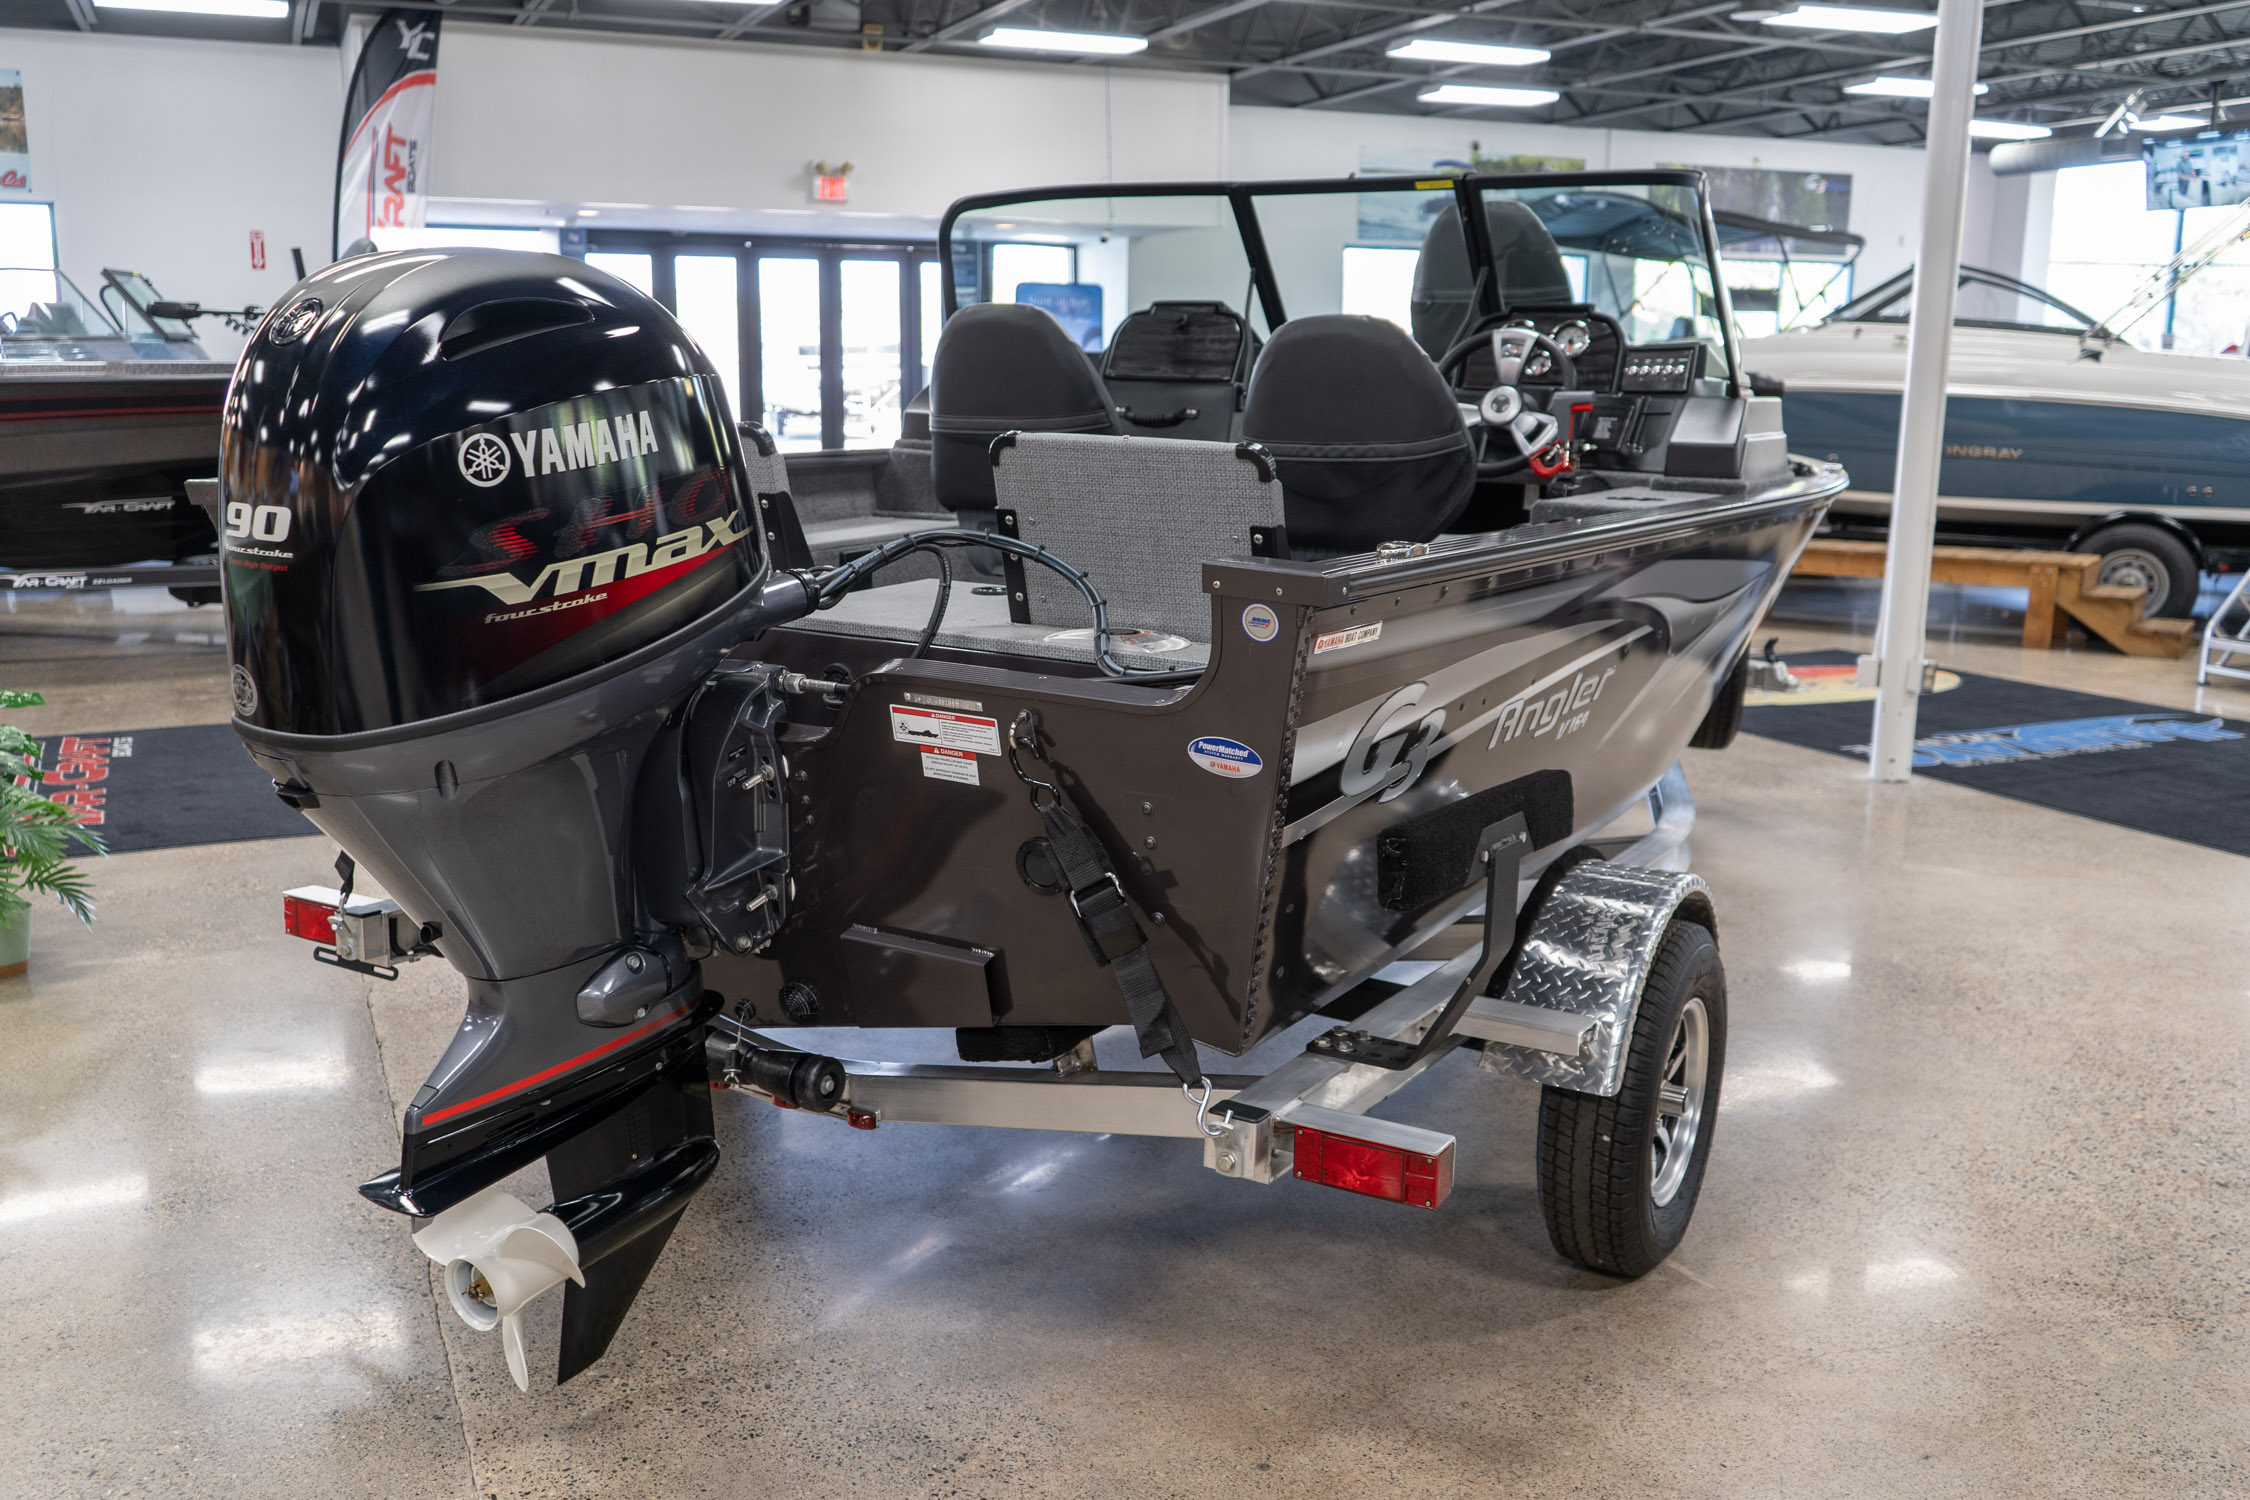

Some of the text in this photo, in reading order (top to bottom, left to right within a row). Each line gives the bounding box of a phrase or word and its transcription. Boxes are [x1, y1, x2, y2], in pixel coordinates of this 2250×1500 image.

[378, 122, 407, 228] RAFT
[819, 176, 845, 200] EXIT
[510, 410, 659, 478] YAMAHA
[1945, 445, 2024, 459] INGRAY
[226, 501, 292, 542] 90
[437, 464, 731, 576] SHO
[1324, 626, 1379, 648] YAMAHA BOAT COMPANY
[1487, 665, 1616, 750] Angler
[941, 749, 963, 757] DANGER
[1198, 741, 1249, 757] PowerMatched
[1339, 680, 1446, 804] G3
[1217, 762, 1240, 772] YAMAHA
